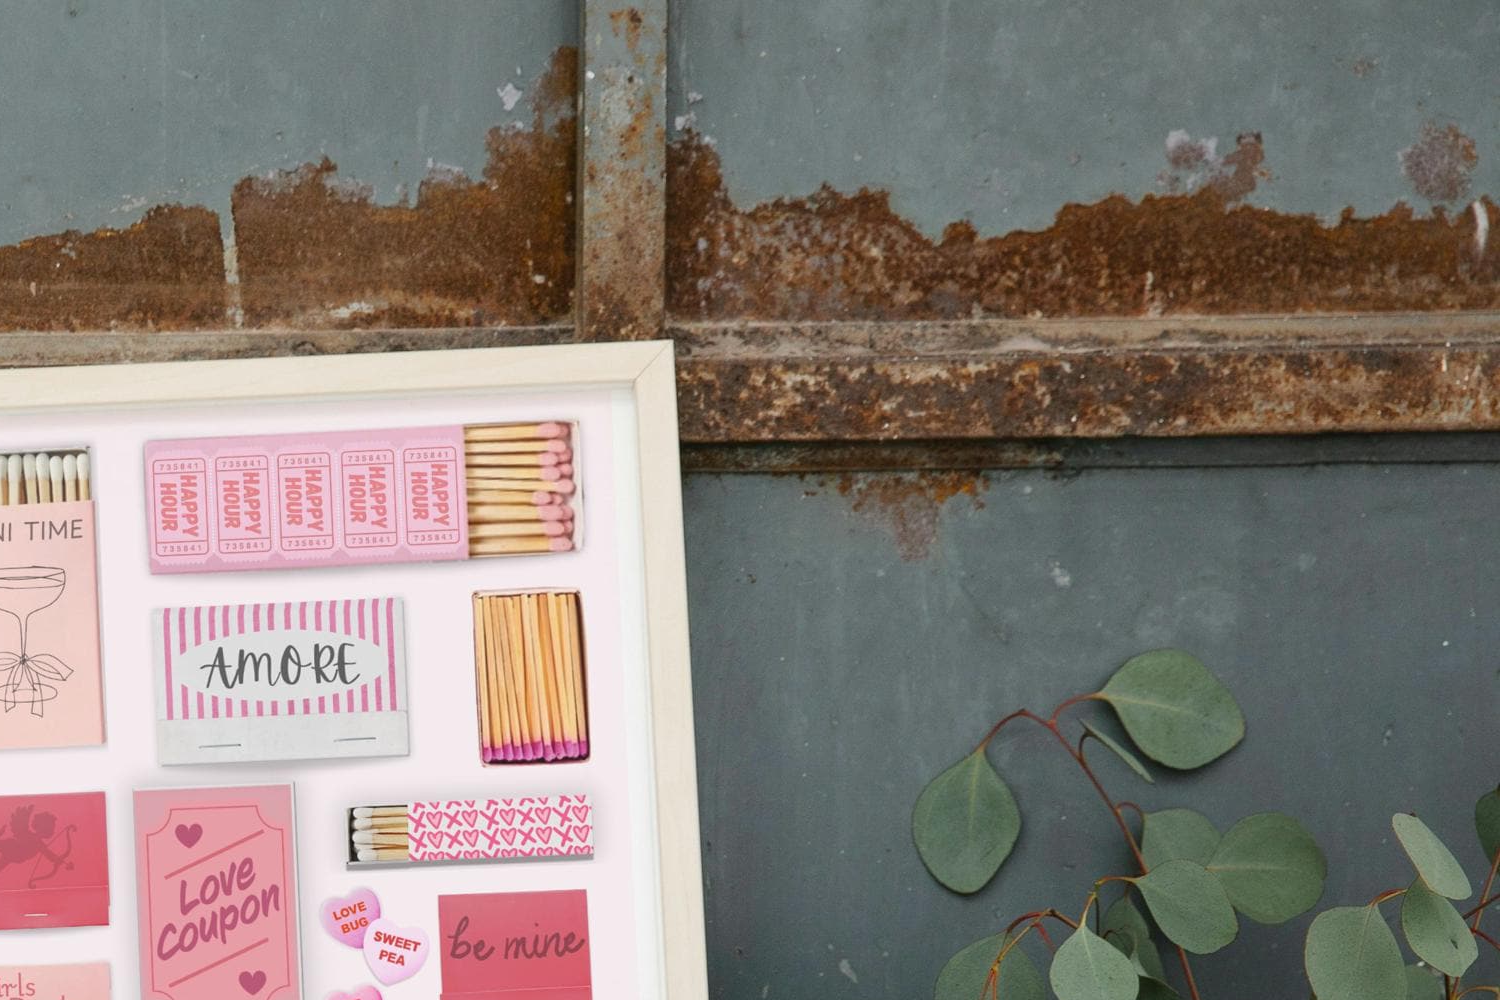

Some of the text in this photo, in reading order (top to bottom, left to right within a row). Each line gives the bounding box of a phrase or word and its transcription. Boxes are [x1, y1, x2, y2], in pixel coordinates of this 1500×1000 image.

[160, 483, 178, 532] HOUR
[180, 475, 199, 537] HAPPY
[222, 480, 240, 529] HOUR
[242, 472, 262, 534] HAPPY
[285, 478, 304, 526] HOUR
[305, 470, 324, 532] HAPPY
[348, 474, 367, 524] HOUR
[368, 466, 388, 528] HAPPY
[410, 472, 429, 520] HOUR
[431, 464, 450, 526] HAPPY
[24, 518, 84, 541] TIME
[200, 642, 361, 690] AMORE
[180, 857, 256, 916] Love
[332, 901, 367, 921] LOVE
[341, 916, 369, 935] BUG
[373, 931, 421, 952] SWEET
[378, 950, 406, 966] PEA
[448, 915, 585, 961] be mine
